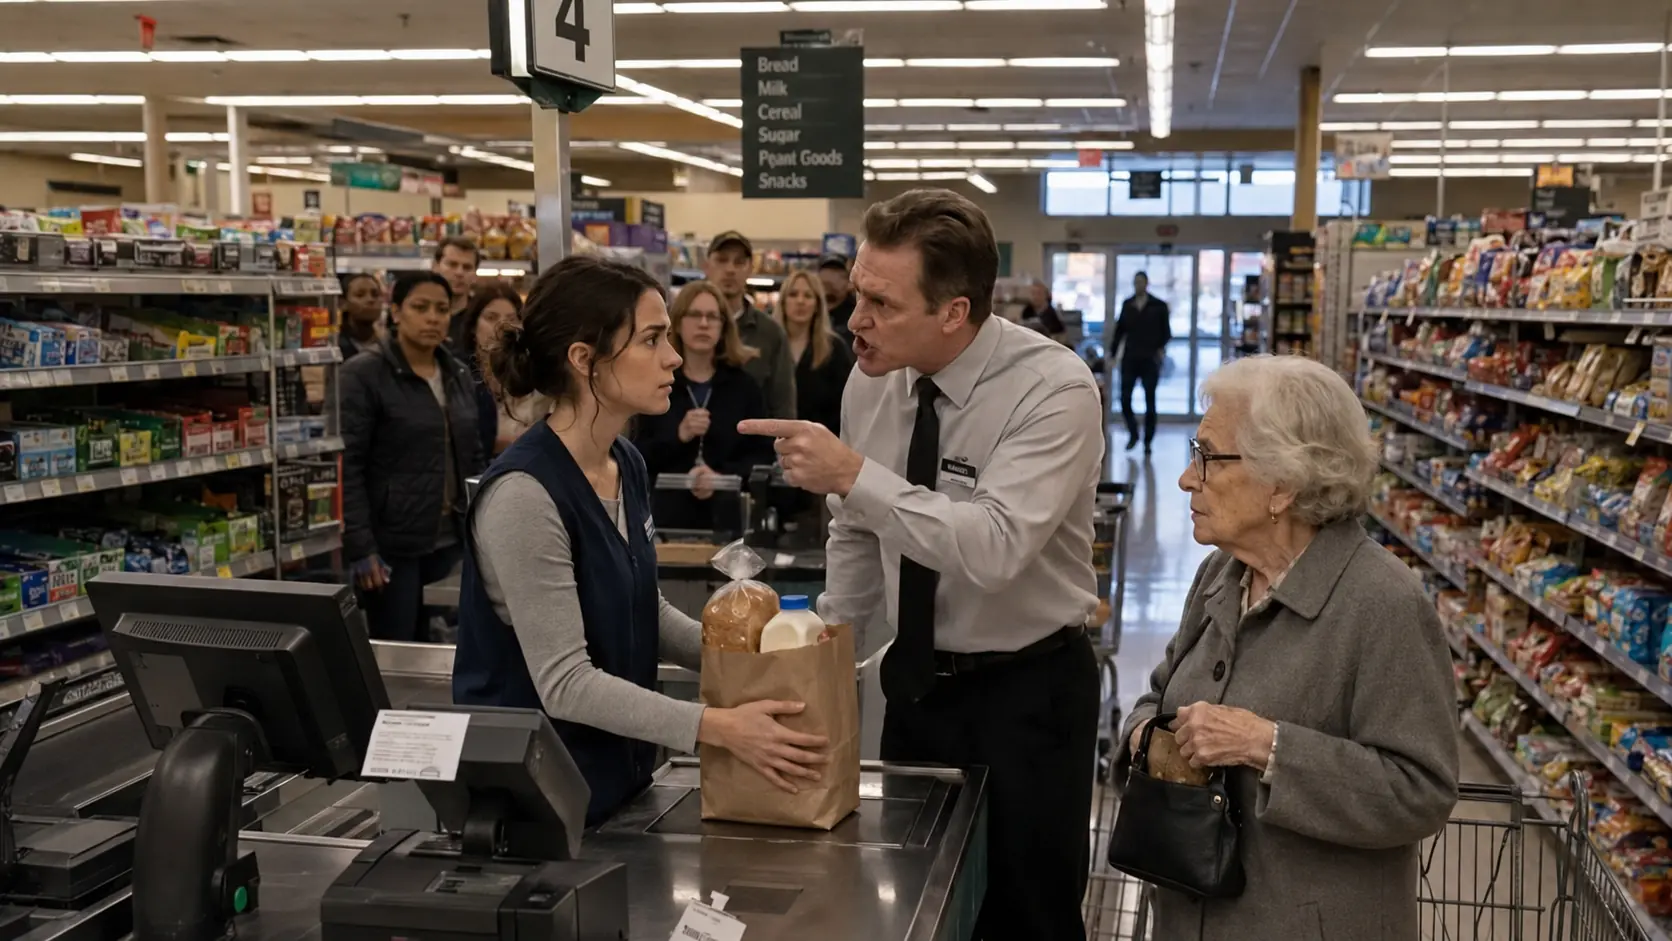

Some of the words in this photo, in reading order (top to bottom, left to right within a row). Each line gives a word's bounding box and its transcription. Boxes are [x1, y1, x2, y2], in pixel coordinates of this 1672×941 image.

[555, 0, 590, 63] 4
[758, 56, 798, 73] Bread
[758, 80, 788, 96] Milk
[758, 104, 801, 120] Cereal
[758, 126, 801, 144] Sugar
[800, 148, 843, 166] Goods
[758, 172, 807, 189] Snacks
